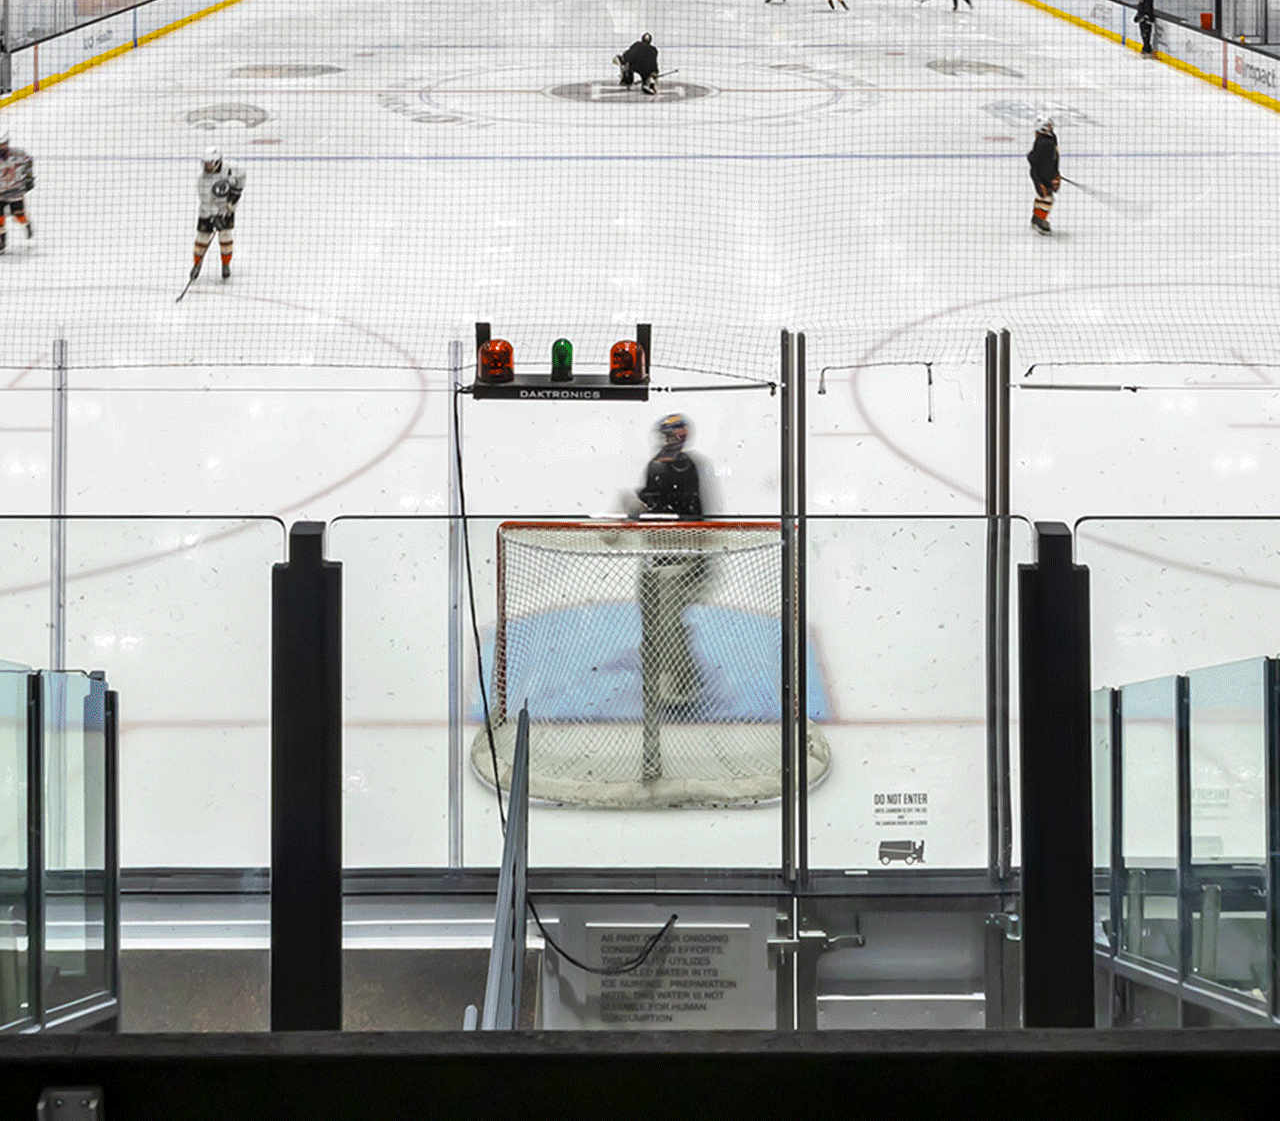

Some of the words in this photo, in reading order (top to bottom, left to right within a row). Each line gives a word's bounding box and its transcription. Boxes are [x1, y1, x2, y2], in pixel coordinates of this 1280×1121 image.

[519, 390, 601, 399] DAKTRONICS
[874, 793, 886, 805] DO
[887, 793, 902, 805] NOT
[903, 792, 928, 805] ENTER
[616, 934, 640, 943] PART
[682, 934, 729, 944] ONGOING
[669, 956, 711, 966] UTILIZES
[656, 968, 689, 977] WATER
[691, 968, 701, 977] IN
[703, 968, 718, 977] ITS
[601, 979, 617, 988] ICE
[669, 979, 737, 989] PREPARATION
[657, 991, 690, 999] WATER
[693, 991, 702, 999] IS
[704, 991, 724, 999] NOT
[648, 1003, 669, 1011] FOR
[671, 1003, 707, 1011] HUMAN
